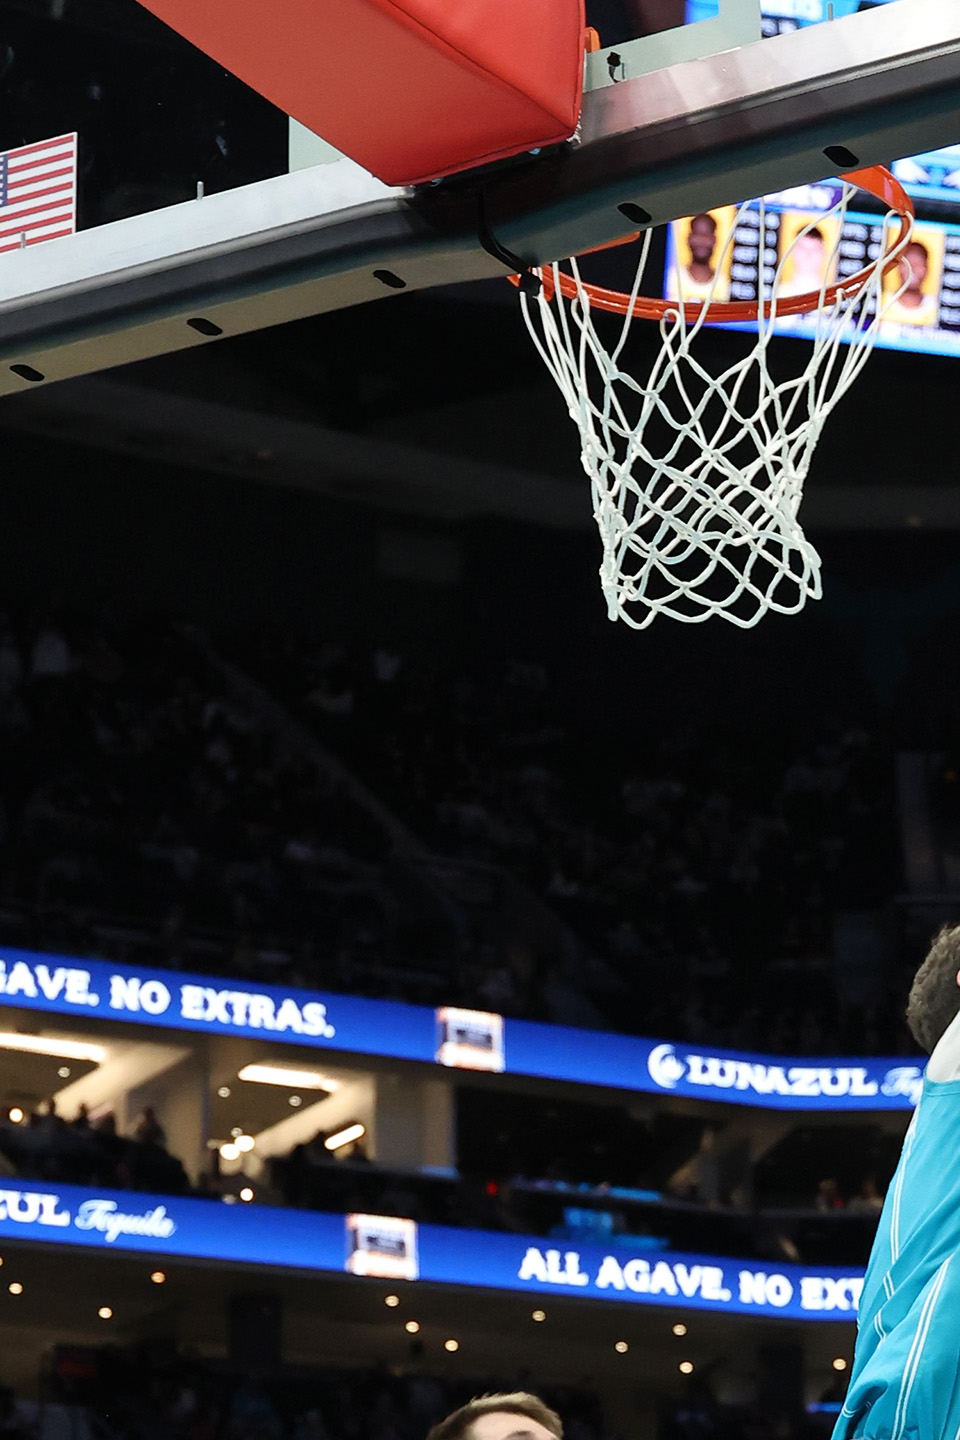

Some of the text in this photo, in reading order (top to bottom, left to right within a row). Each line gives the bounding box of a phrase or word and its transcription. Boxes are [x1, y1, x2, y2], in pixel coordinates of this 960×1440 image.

[0, 958, 336, 1039] AVE. NO EXTRAS.
[686, 1054, 879, 1097] LUNAZUL
[518, 1247, 589, 1287] ALL
[595, 1255, 732, 1302] AGAVE.
[739, 1270, 793, 1308] NO
